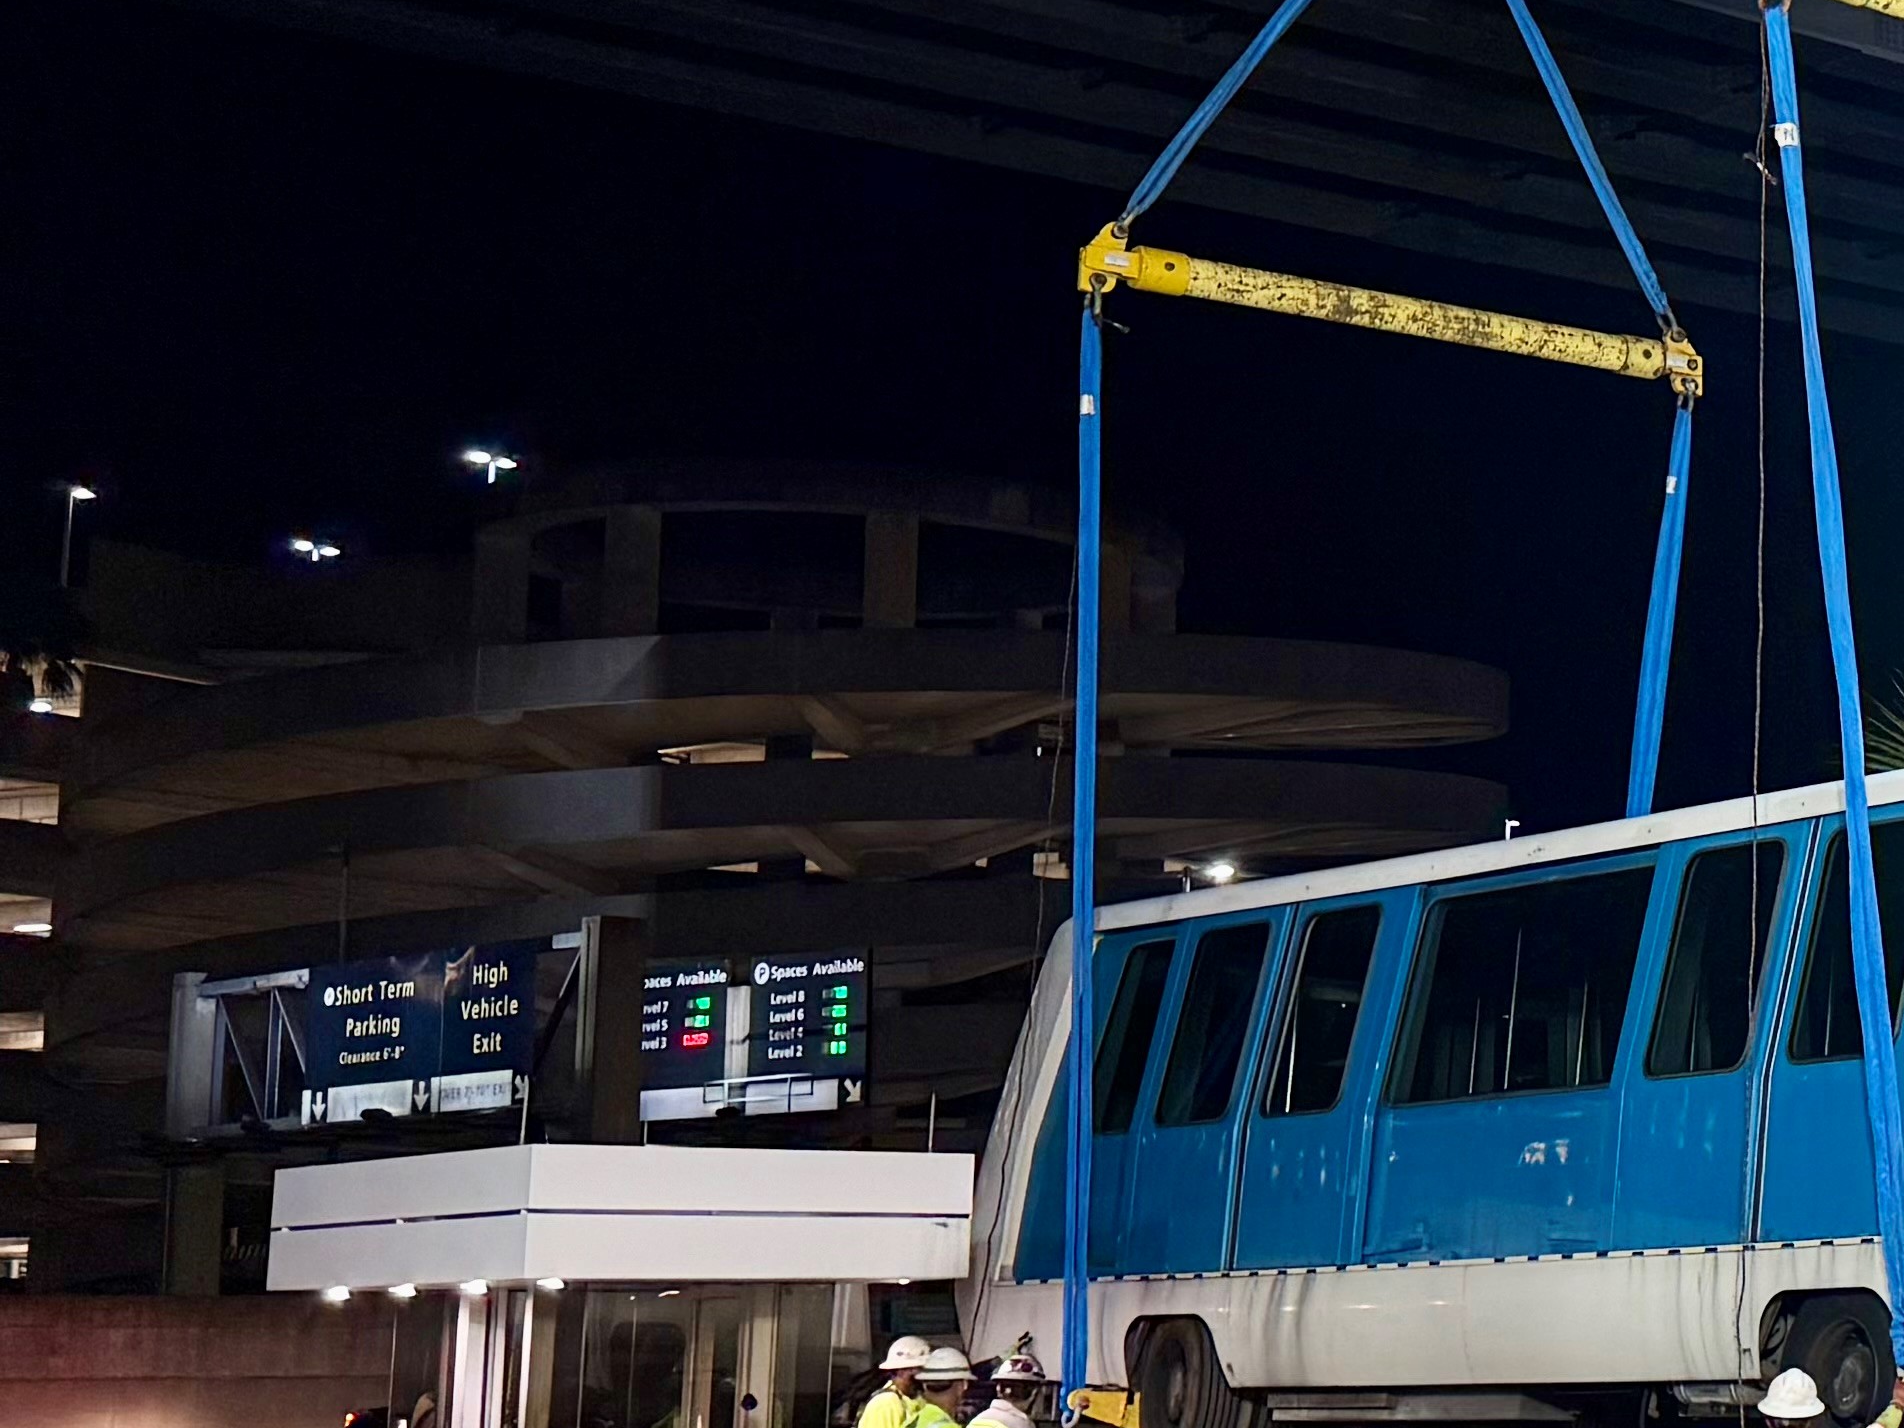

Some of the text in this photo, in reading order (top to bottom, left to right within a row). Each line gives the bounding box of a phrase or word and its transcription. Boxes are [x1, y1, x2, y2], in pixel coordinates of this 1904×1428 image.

[472, 960, 509, 988] High
[676, 969, 727, 987] Available
[771, 965, 808, 982] Spaces
[812, 959, 865, 975] Available
[335, 980, 415, 1006] Short Term
[770, 990, 805, 1005] Level 8
[461, 994, 519, 1021] Vehicle
[661, 1000, 669, 1013] 7
[769, 1008, 805, 1023] Level 6
[345, 1013, 401, 1038] Parking
[661, 1019, 668, 1031] 5
[472, 1032, 502, 1054] Exit
[659, 1037, 667, 1049] 3
[768, 1029, 795, 1042] Level
[339, 1050, 381, 1065] Clearance
[767, 1045, 803, 1060] Level 2
